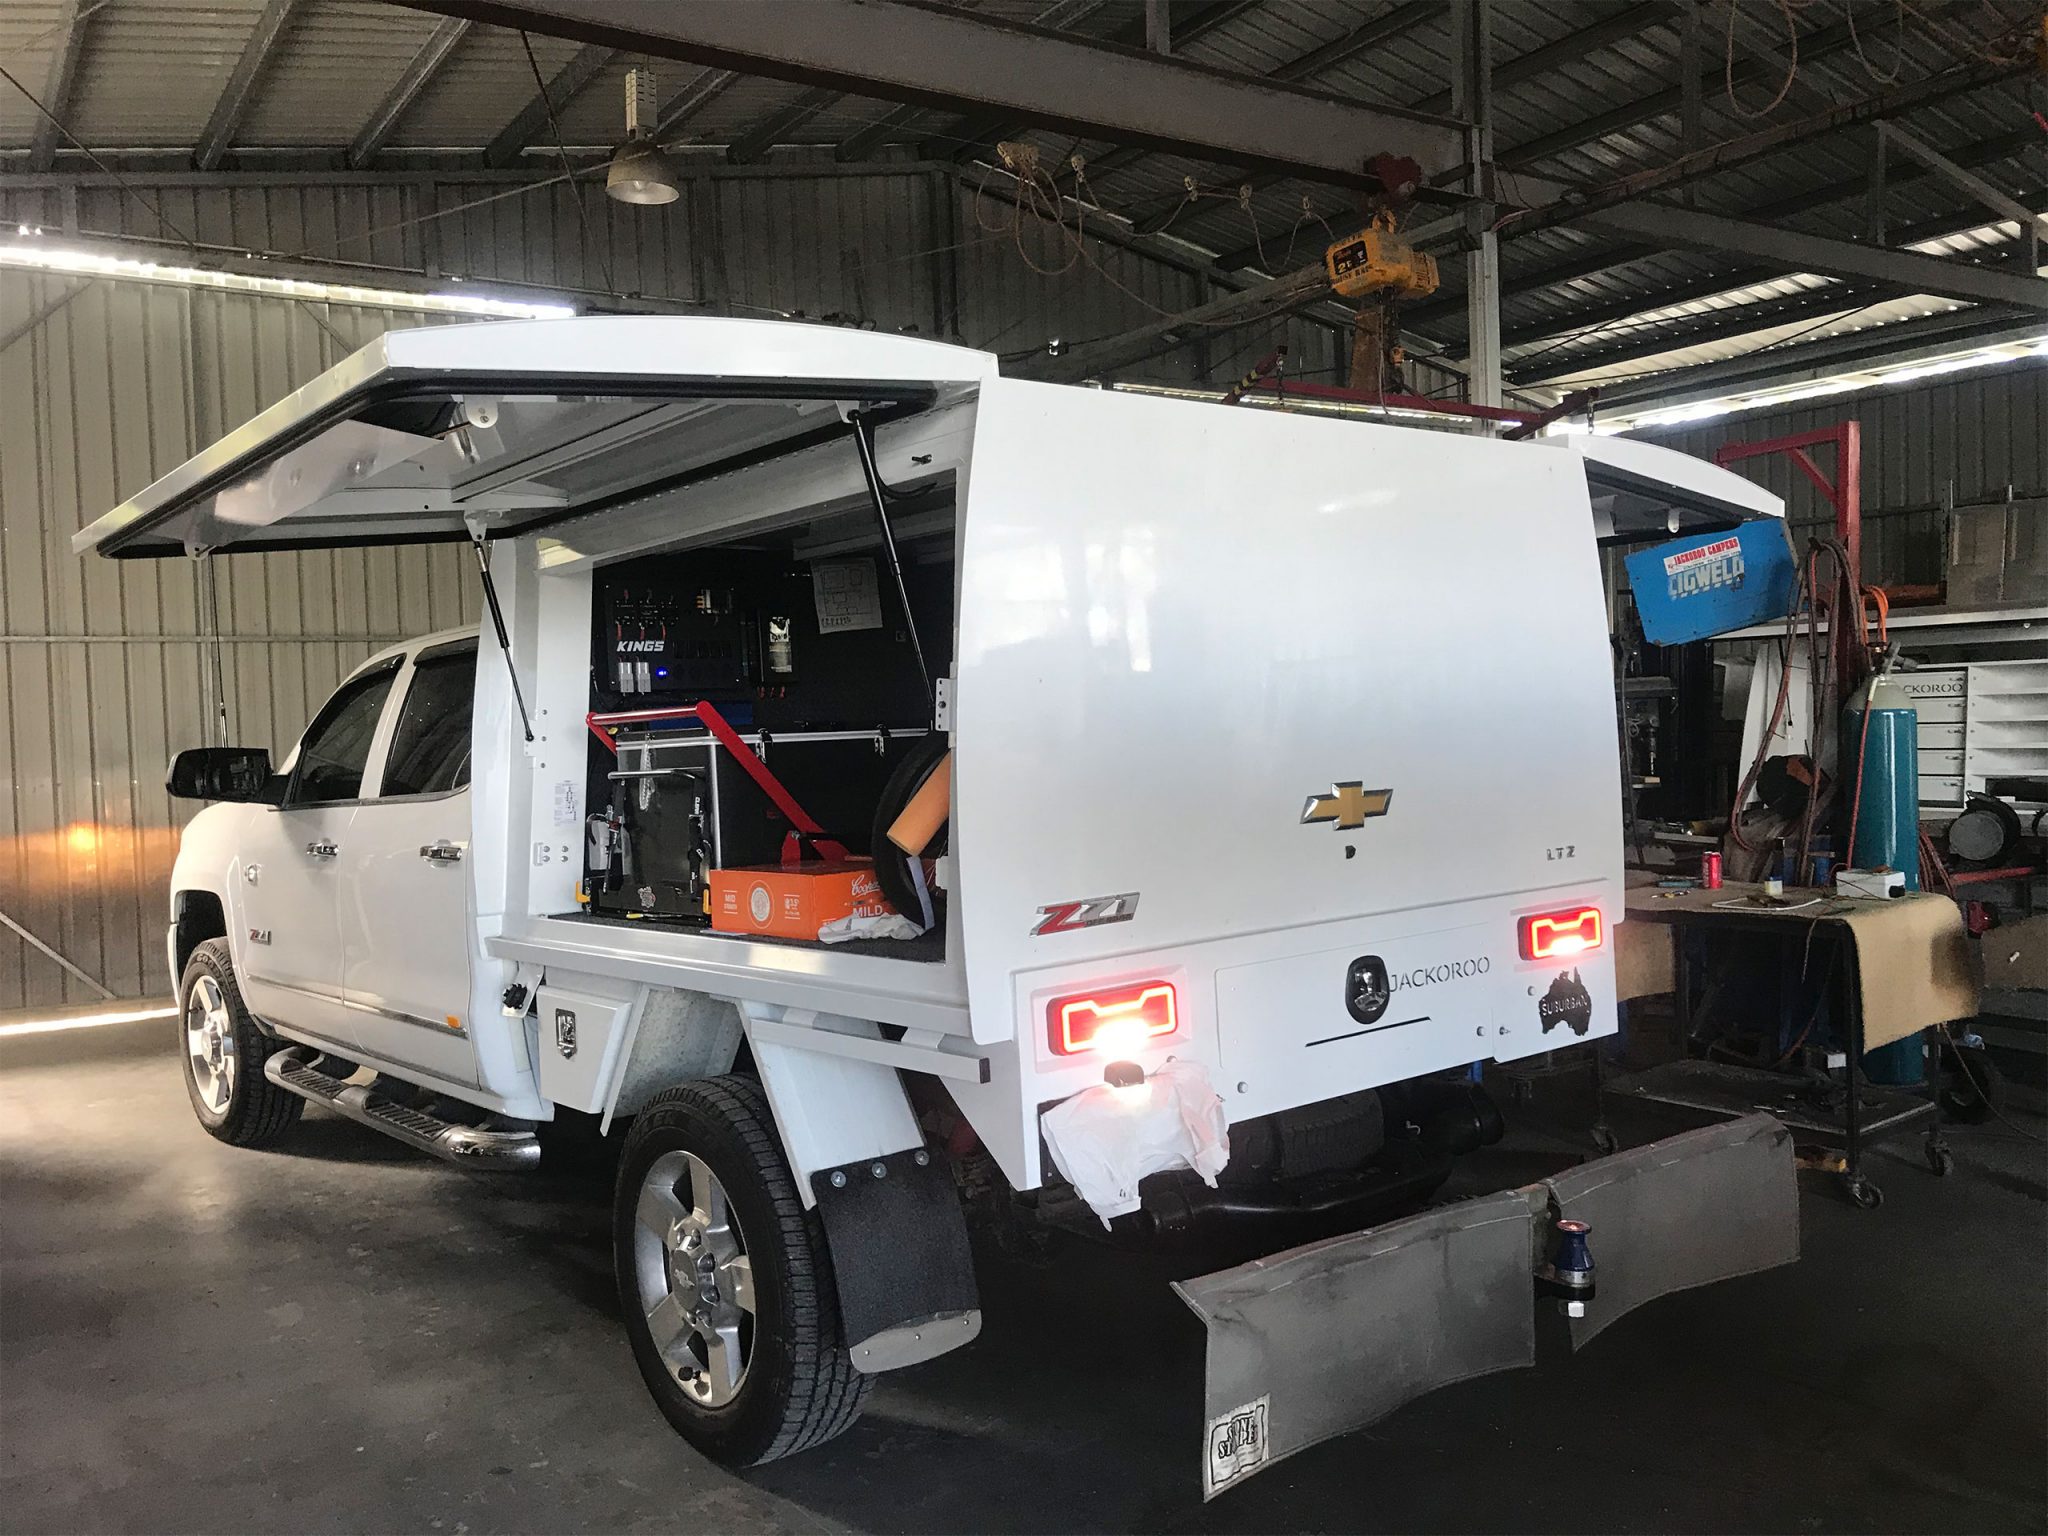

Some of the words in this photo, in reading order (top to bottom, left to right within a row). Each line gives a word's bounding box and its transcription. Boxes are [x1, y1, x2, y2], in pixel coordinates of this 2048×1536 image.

[1673, 547, 1706, 565] JACKOROO
[1707, 538, 1739, 555] CAMPERS
[616, 640, 665, 652] KINGS
[1903, 683, 1963, 694] CKOROO
[1546, 845, 1576, 861] LTZ
[852, 904, 883, 918] MILD
[1029, 892, 1141, 936] Z71
[250, 929, 272, 946] Z71
[1389, 956, 1490, 993] JACKOROO
[1541, 996, 1588, 1016] SUBURBAN
